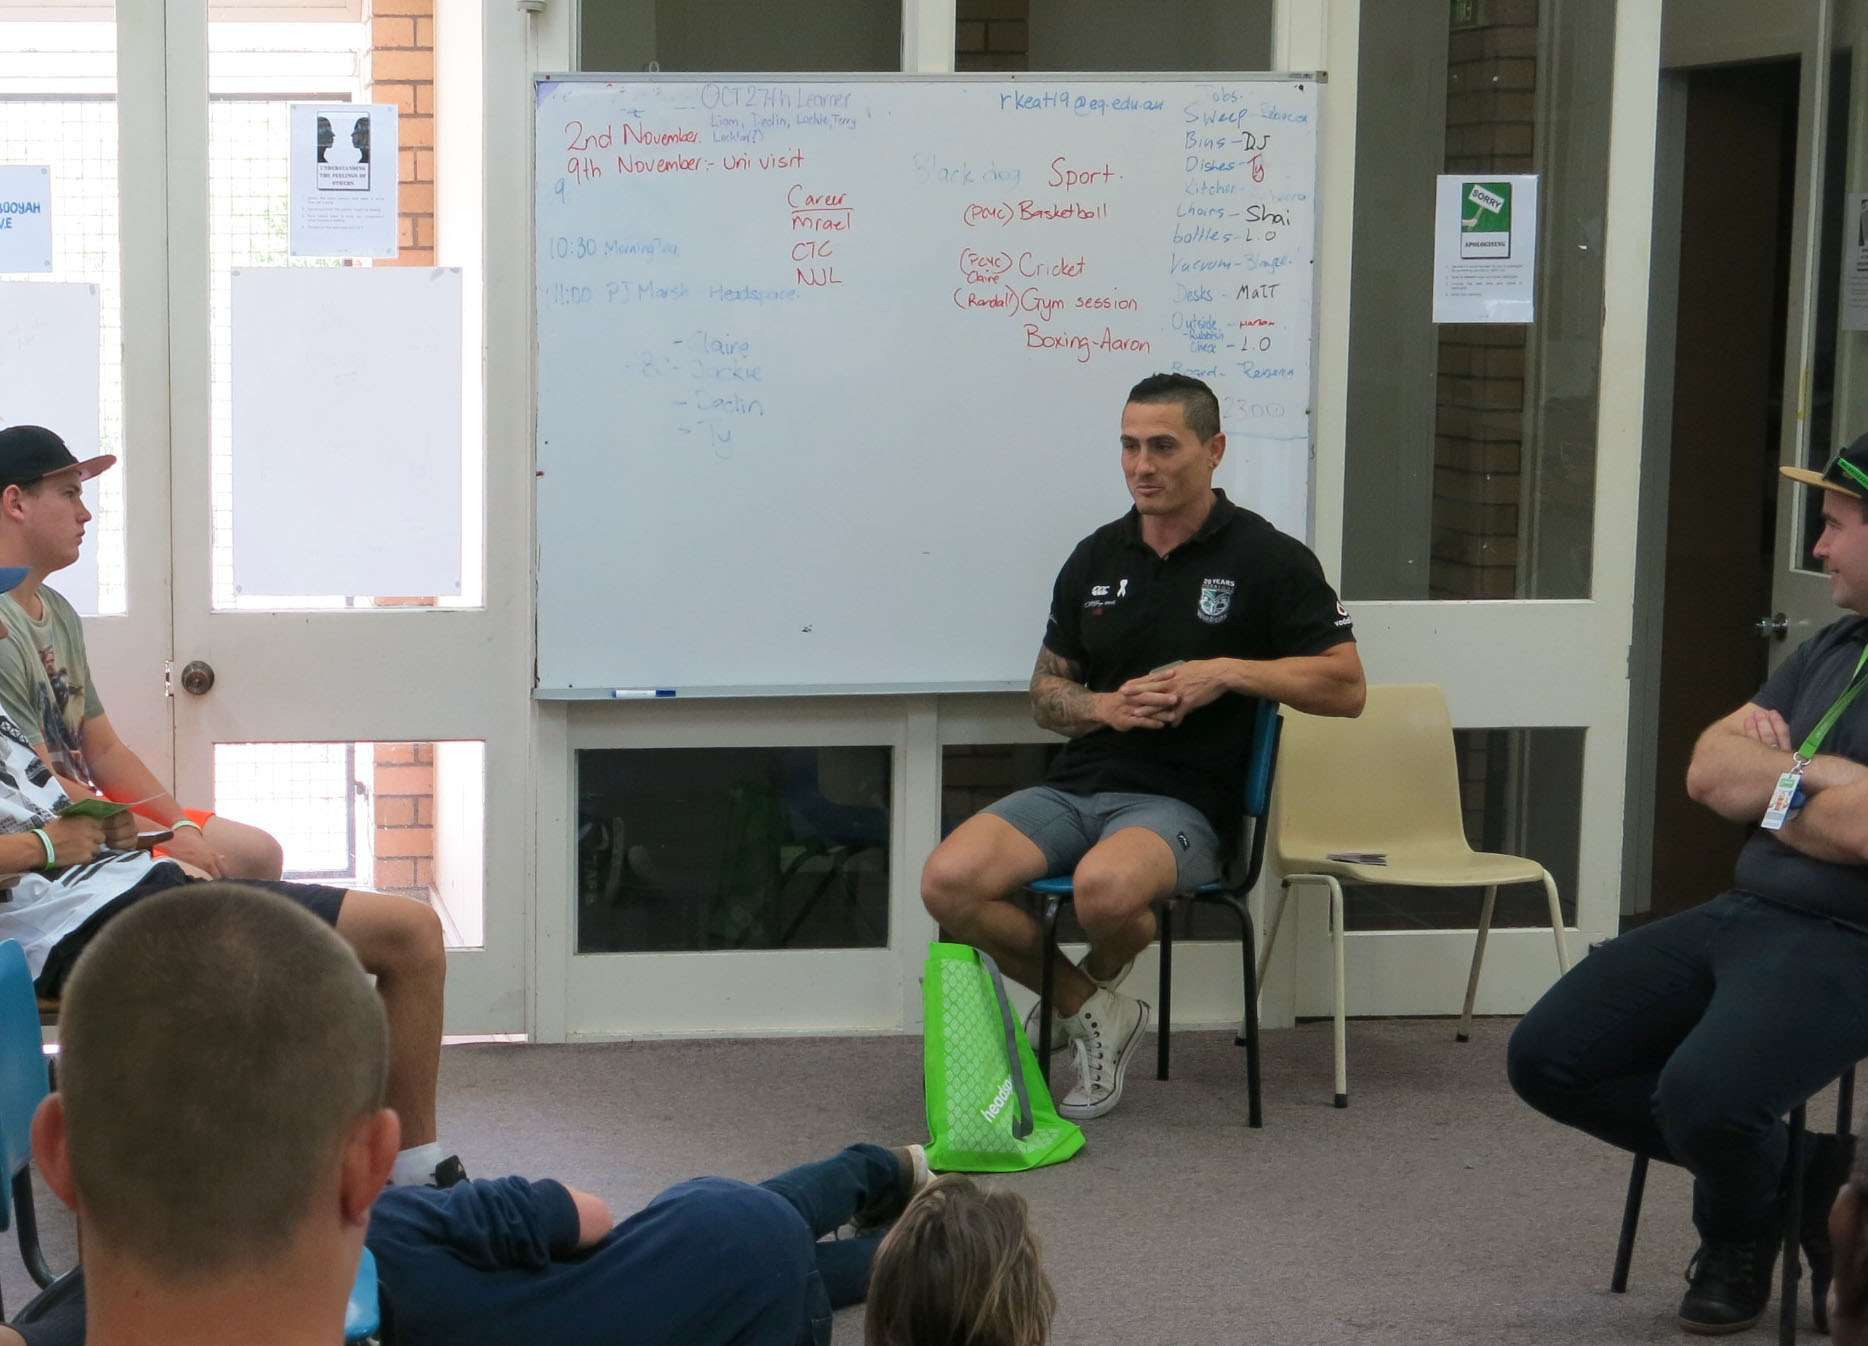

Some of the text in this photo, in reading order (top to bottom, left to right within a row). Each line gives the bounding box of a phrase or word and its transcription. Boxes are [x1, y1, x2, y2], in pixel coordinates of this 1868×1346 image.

[1184, 101, 1248, 128] Sweep
[566, 121, 613, 151] 2nd
[567, 157, 602, 184] 9th
[760, 148, 806, 170] visit
[787, 184, 848, 208] Career
[1472, 188, 1502, 209] SORRY
[1018, 200, 1109, 220] Basketball
[1019, 252, 1086, 278] Cricket
[1021, 287, 1065, 321] Gym
[1075, 287, 1138, 311] session
